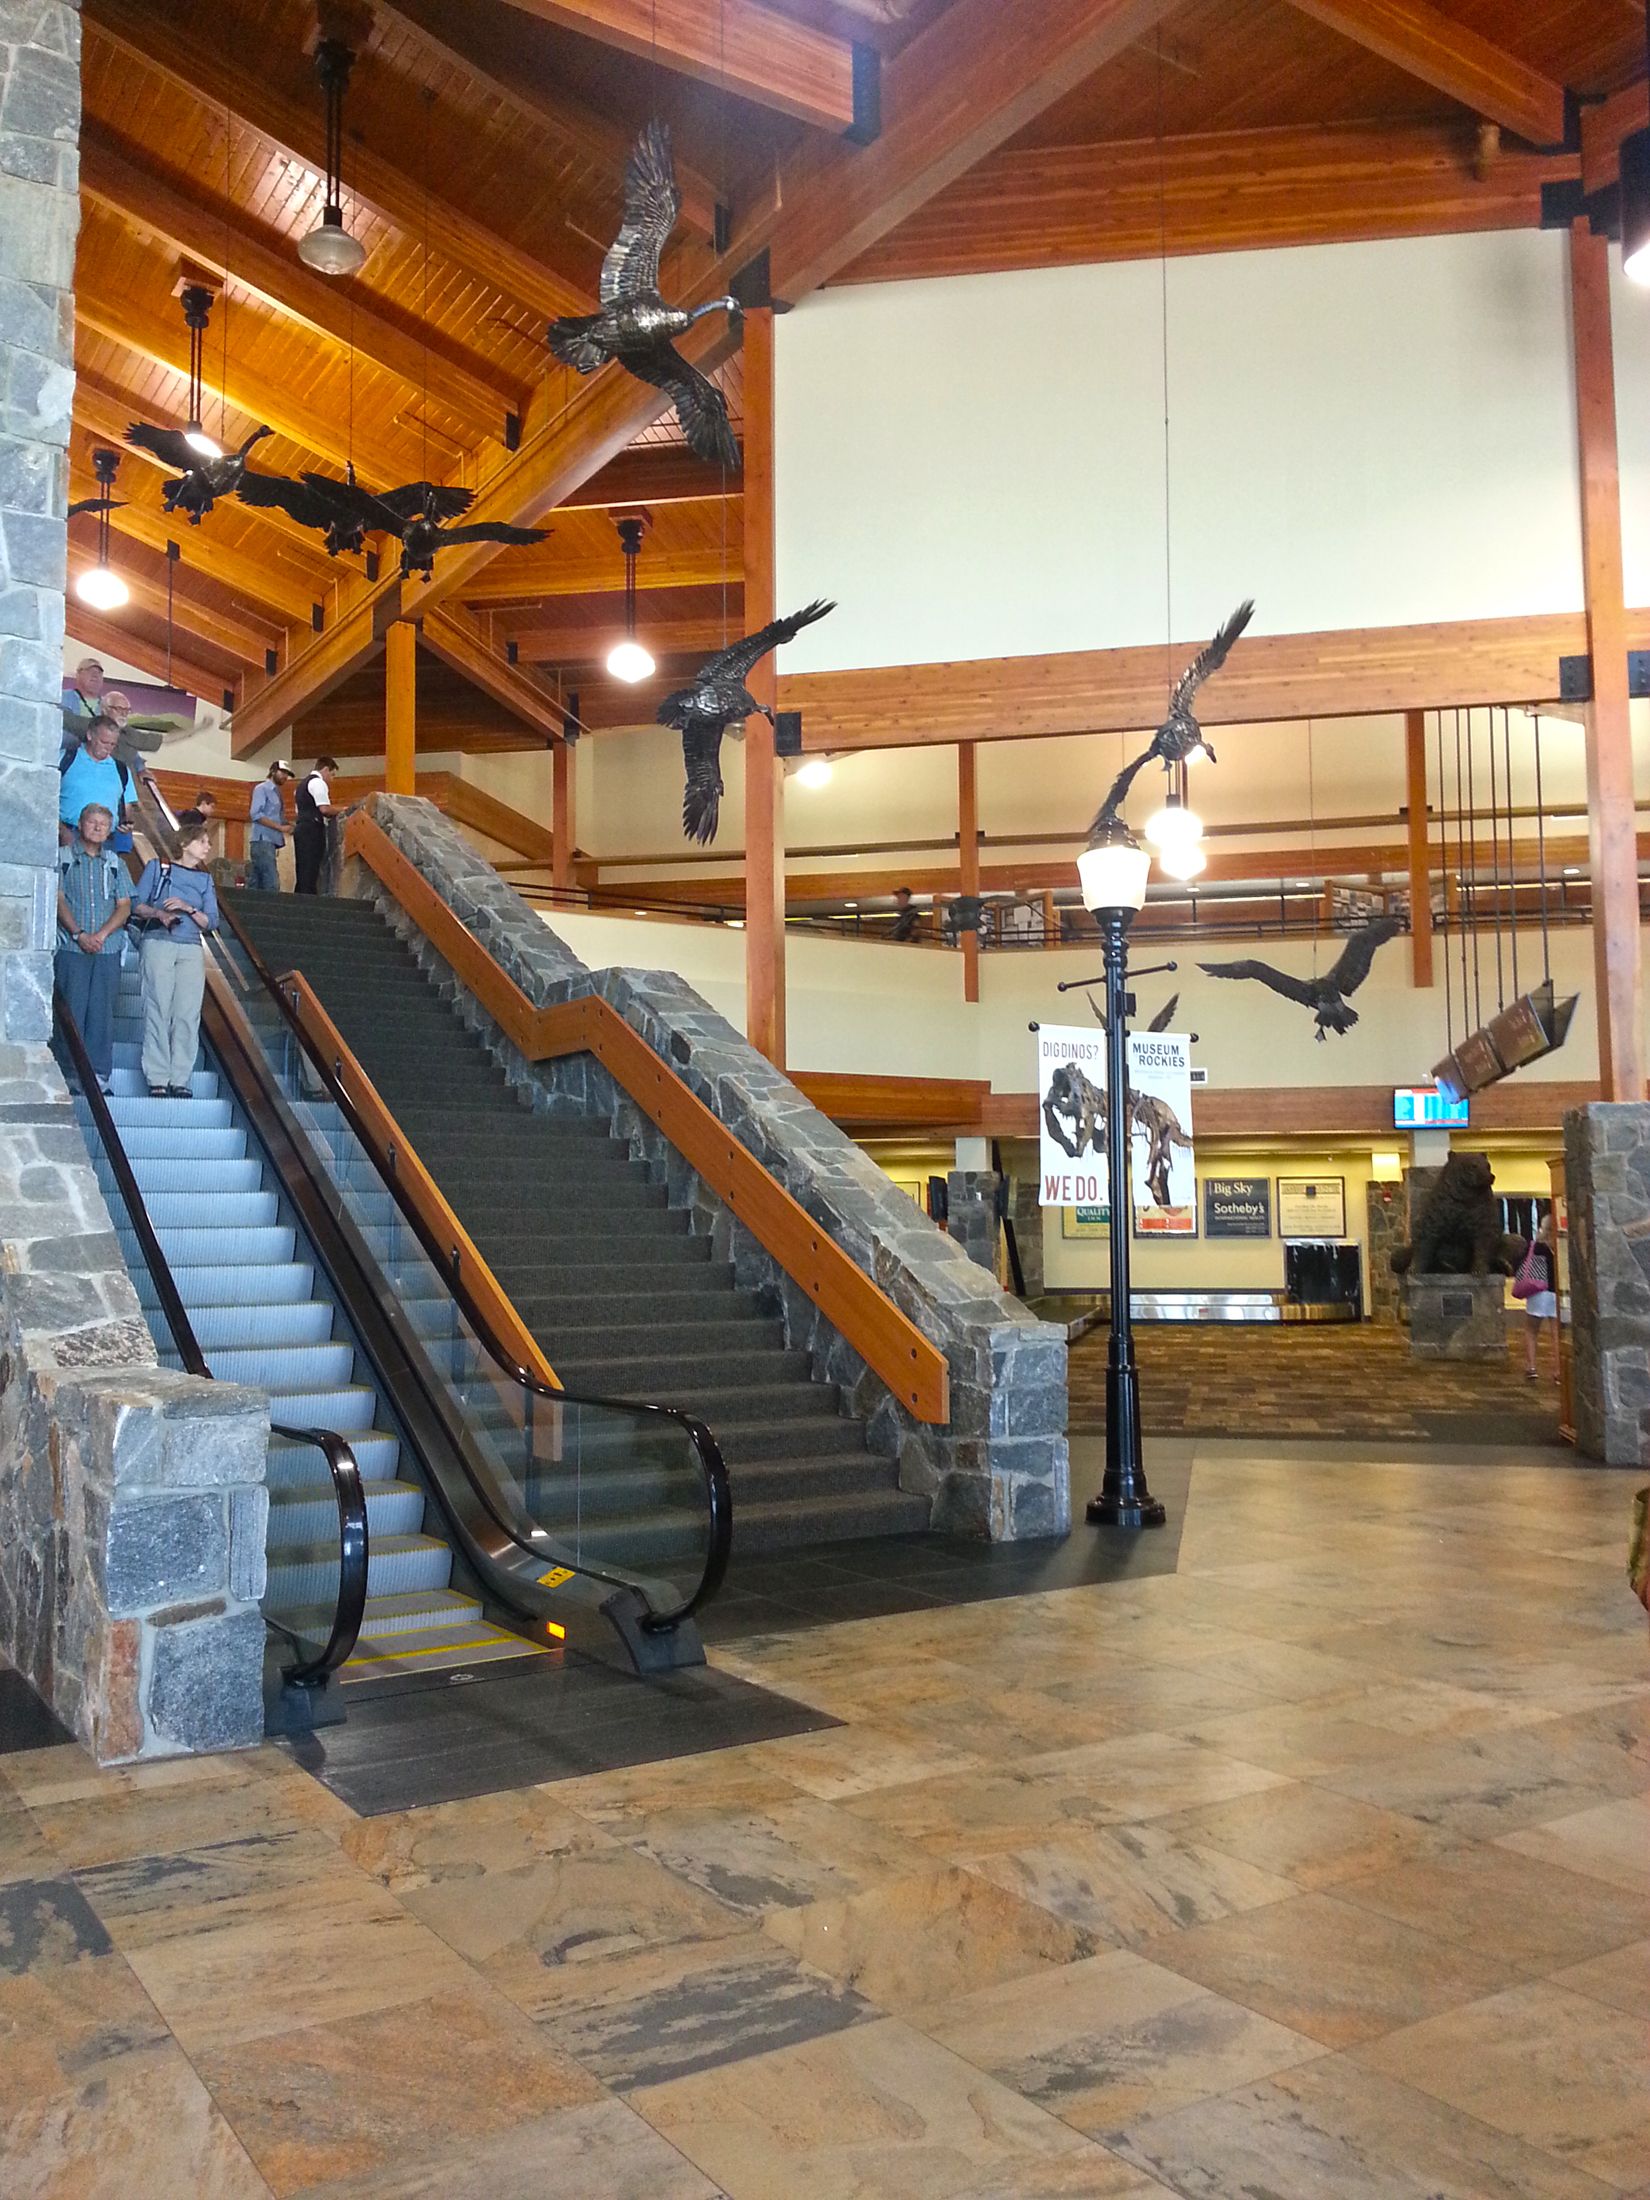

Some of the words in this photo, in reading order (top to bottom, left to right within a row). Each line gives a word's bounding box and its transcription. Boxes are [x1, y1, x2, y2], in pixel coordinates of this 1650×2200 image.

[1043, 1042, 1060, 1058] DIG
[1061, 1042, 1099, 1060] DINOS?
[1133, 1043, 1179, 1055] MUSEUM
[1139, 1055, 1185, 1067] ROCKIES
[1045, 1175, 1071, 1201] WE
[1076, 1175, 1103, 1201] DO.
[1214, 1182, 1232, 1197] Big
[1233, 1181, 1253, 1197] Sky
[1214, 1202, 1265, 1216] Sotheby's
